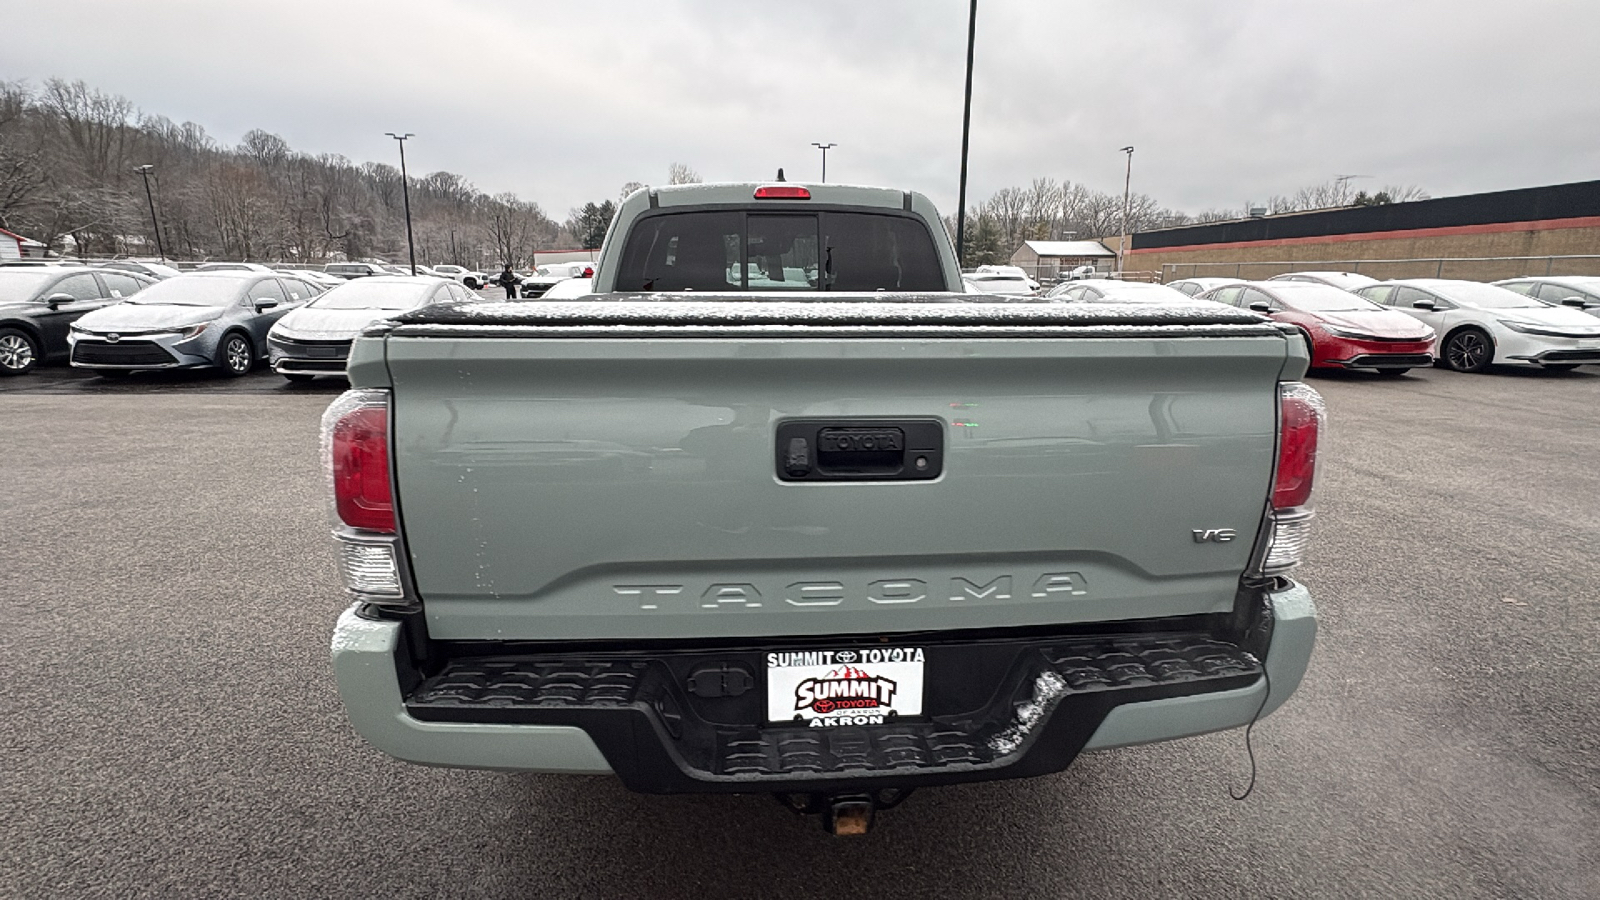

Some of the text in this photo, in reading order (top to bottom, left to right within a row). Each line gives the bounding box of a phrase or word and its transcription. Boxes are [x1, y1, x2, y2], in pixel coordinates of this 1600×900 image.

[824, 434, 898, 450] TOYOTA
[1192, 528, 1237, 543] V6
[612, 571, 1088, 610] TACOMA
[767, 648, 925, 667] SUMMIT TOYOTA
[798, 679, 894, 708] SUMMIT
[836, 700, 878, 709] TOYOTA
[809, 716, 883, 727] AKRON
